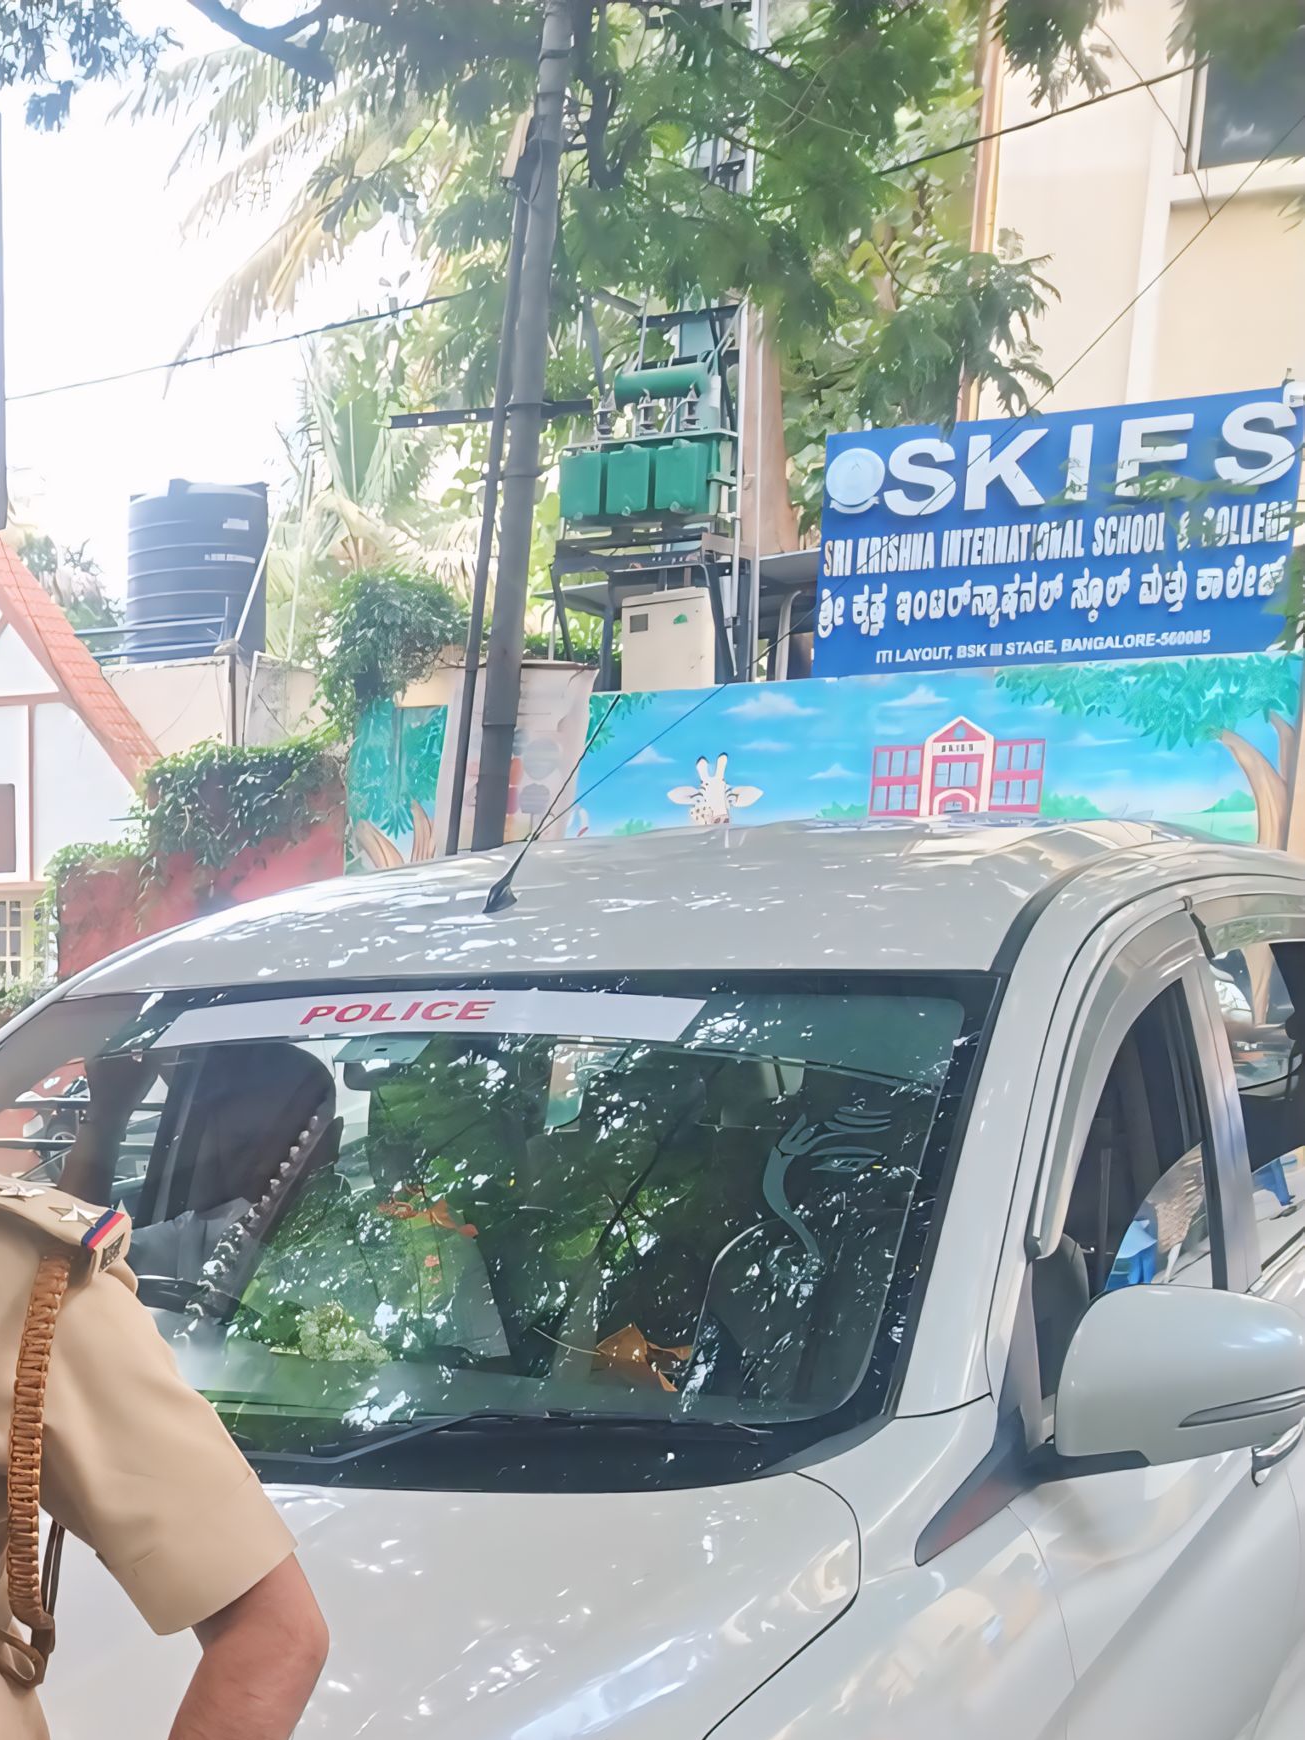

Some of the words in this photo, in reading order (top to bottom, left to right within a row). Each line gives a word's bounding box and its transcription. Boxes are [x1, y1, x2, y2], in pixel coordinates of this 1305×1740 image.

[823, 538, 854, 576] SRI
[856, 531, 935, 574] KRISHNA
[940, 519, 1085, 568] INTERNATIONAL
[1092, 512, 1165, 557] SCHOOL
[817, 588, 845, 639] ಶ್ರೀ
[852, 583, 888, 636] ಕೃಷ್ಣ
[1138, 560, 1188, 612] ಮತ್ತು
[895, 646, 953, 663] LAYOUT,
[956, 643, 988, 659] BSK
[1005, 639, 1058, 657] STAGE,
[299, 1001, 496, 1025] POLICE
